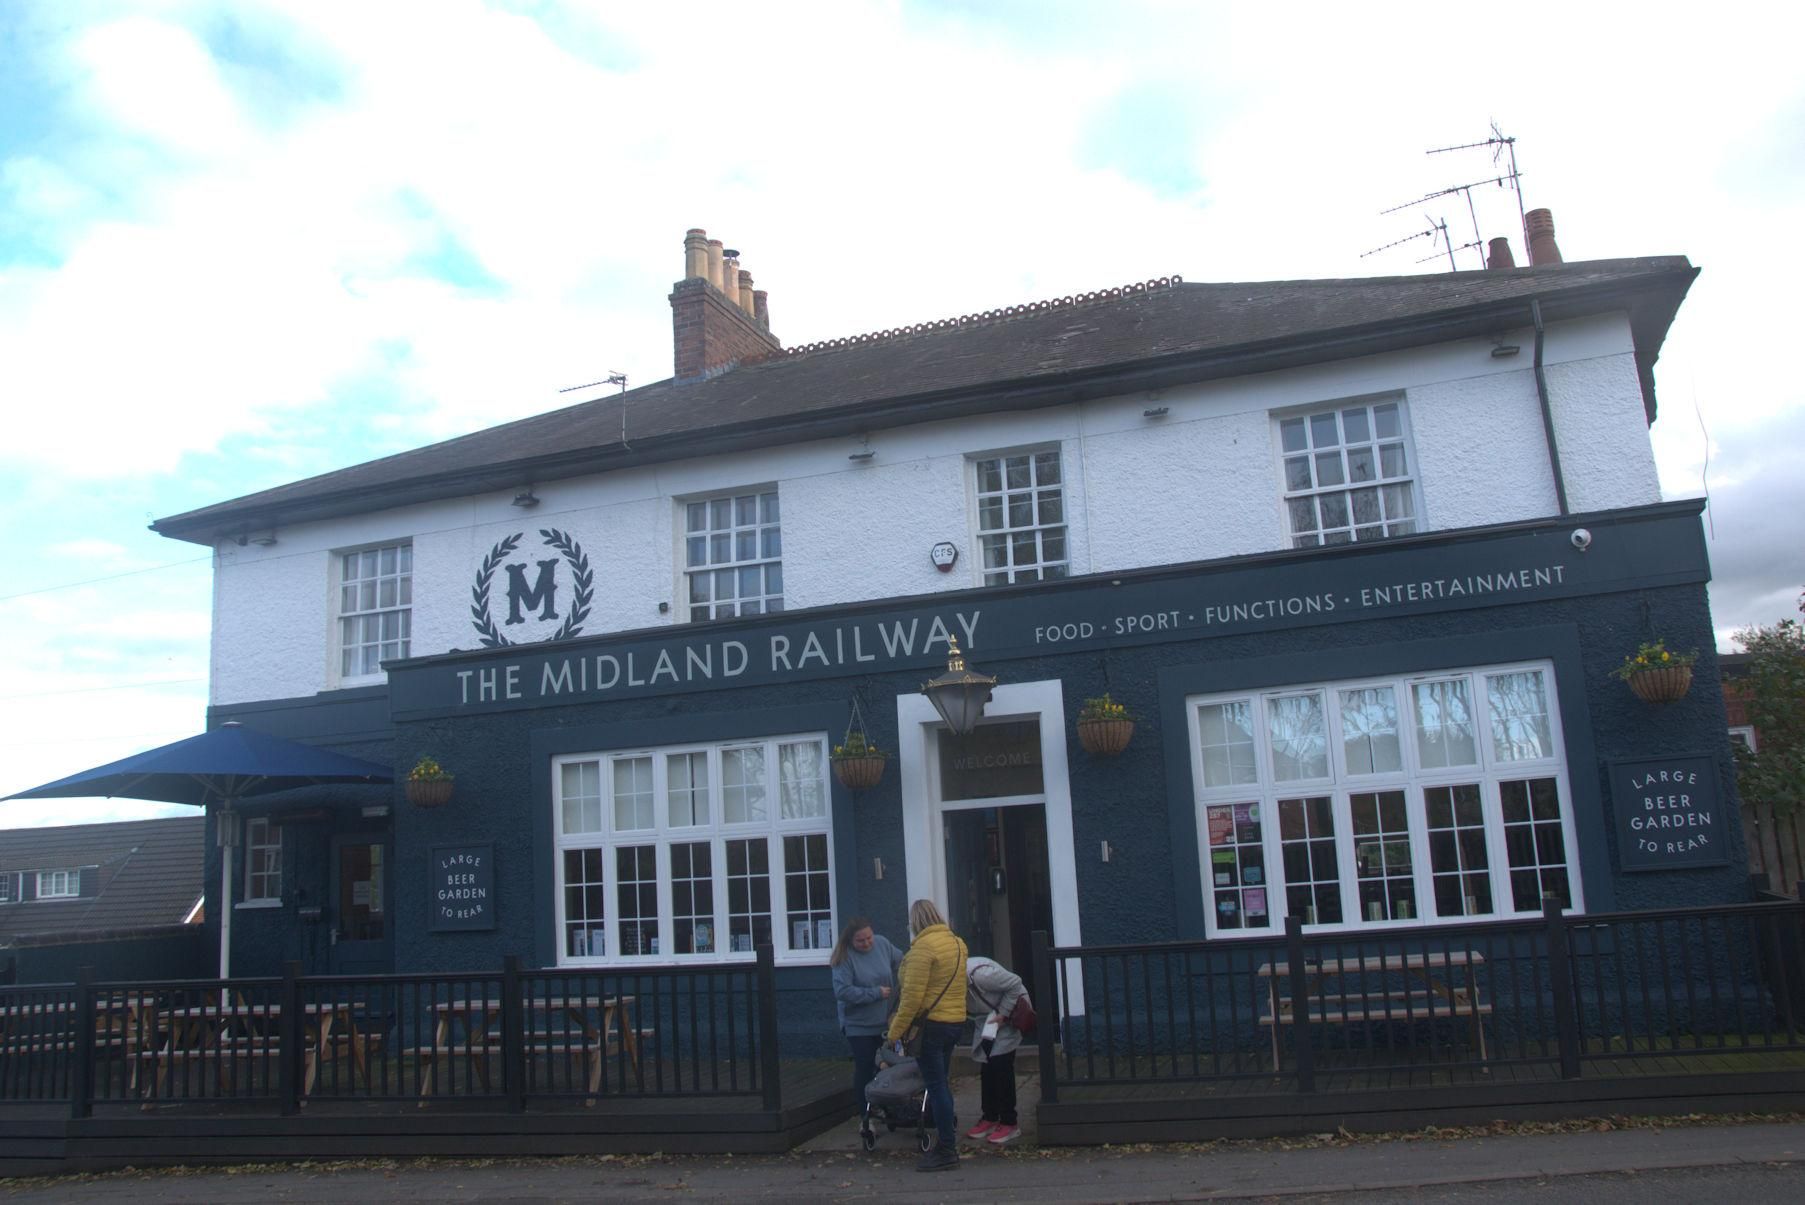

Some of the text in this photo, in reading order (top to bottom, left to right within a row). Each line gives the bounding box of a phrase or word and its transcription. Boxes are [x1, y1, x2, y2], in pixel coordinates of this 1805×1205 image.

[504, 558, 560, 626] M
[1035, 565, 1565, 644] FOOD SPORT FUNCTIONS ENTERTAINMENT
[456, 610, 981, 704] THE MIDLAND RAILWAY
[953, 751, 1032, 771] WELCOME
[1631, 770, 1697, 790] LARGE
[1644, 794, 1691, 811] BEER
[1630, 811, 1711, 831] GARDEN
[1639, 833, 1709, 853] TO REAR
[441, 854, 481, 869] LARGE
[447, 873, 477, 886] BEER
[438, 887, 486, 901] GARDEN
[441, 904, 483, 919] TO REAR
